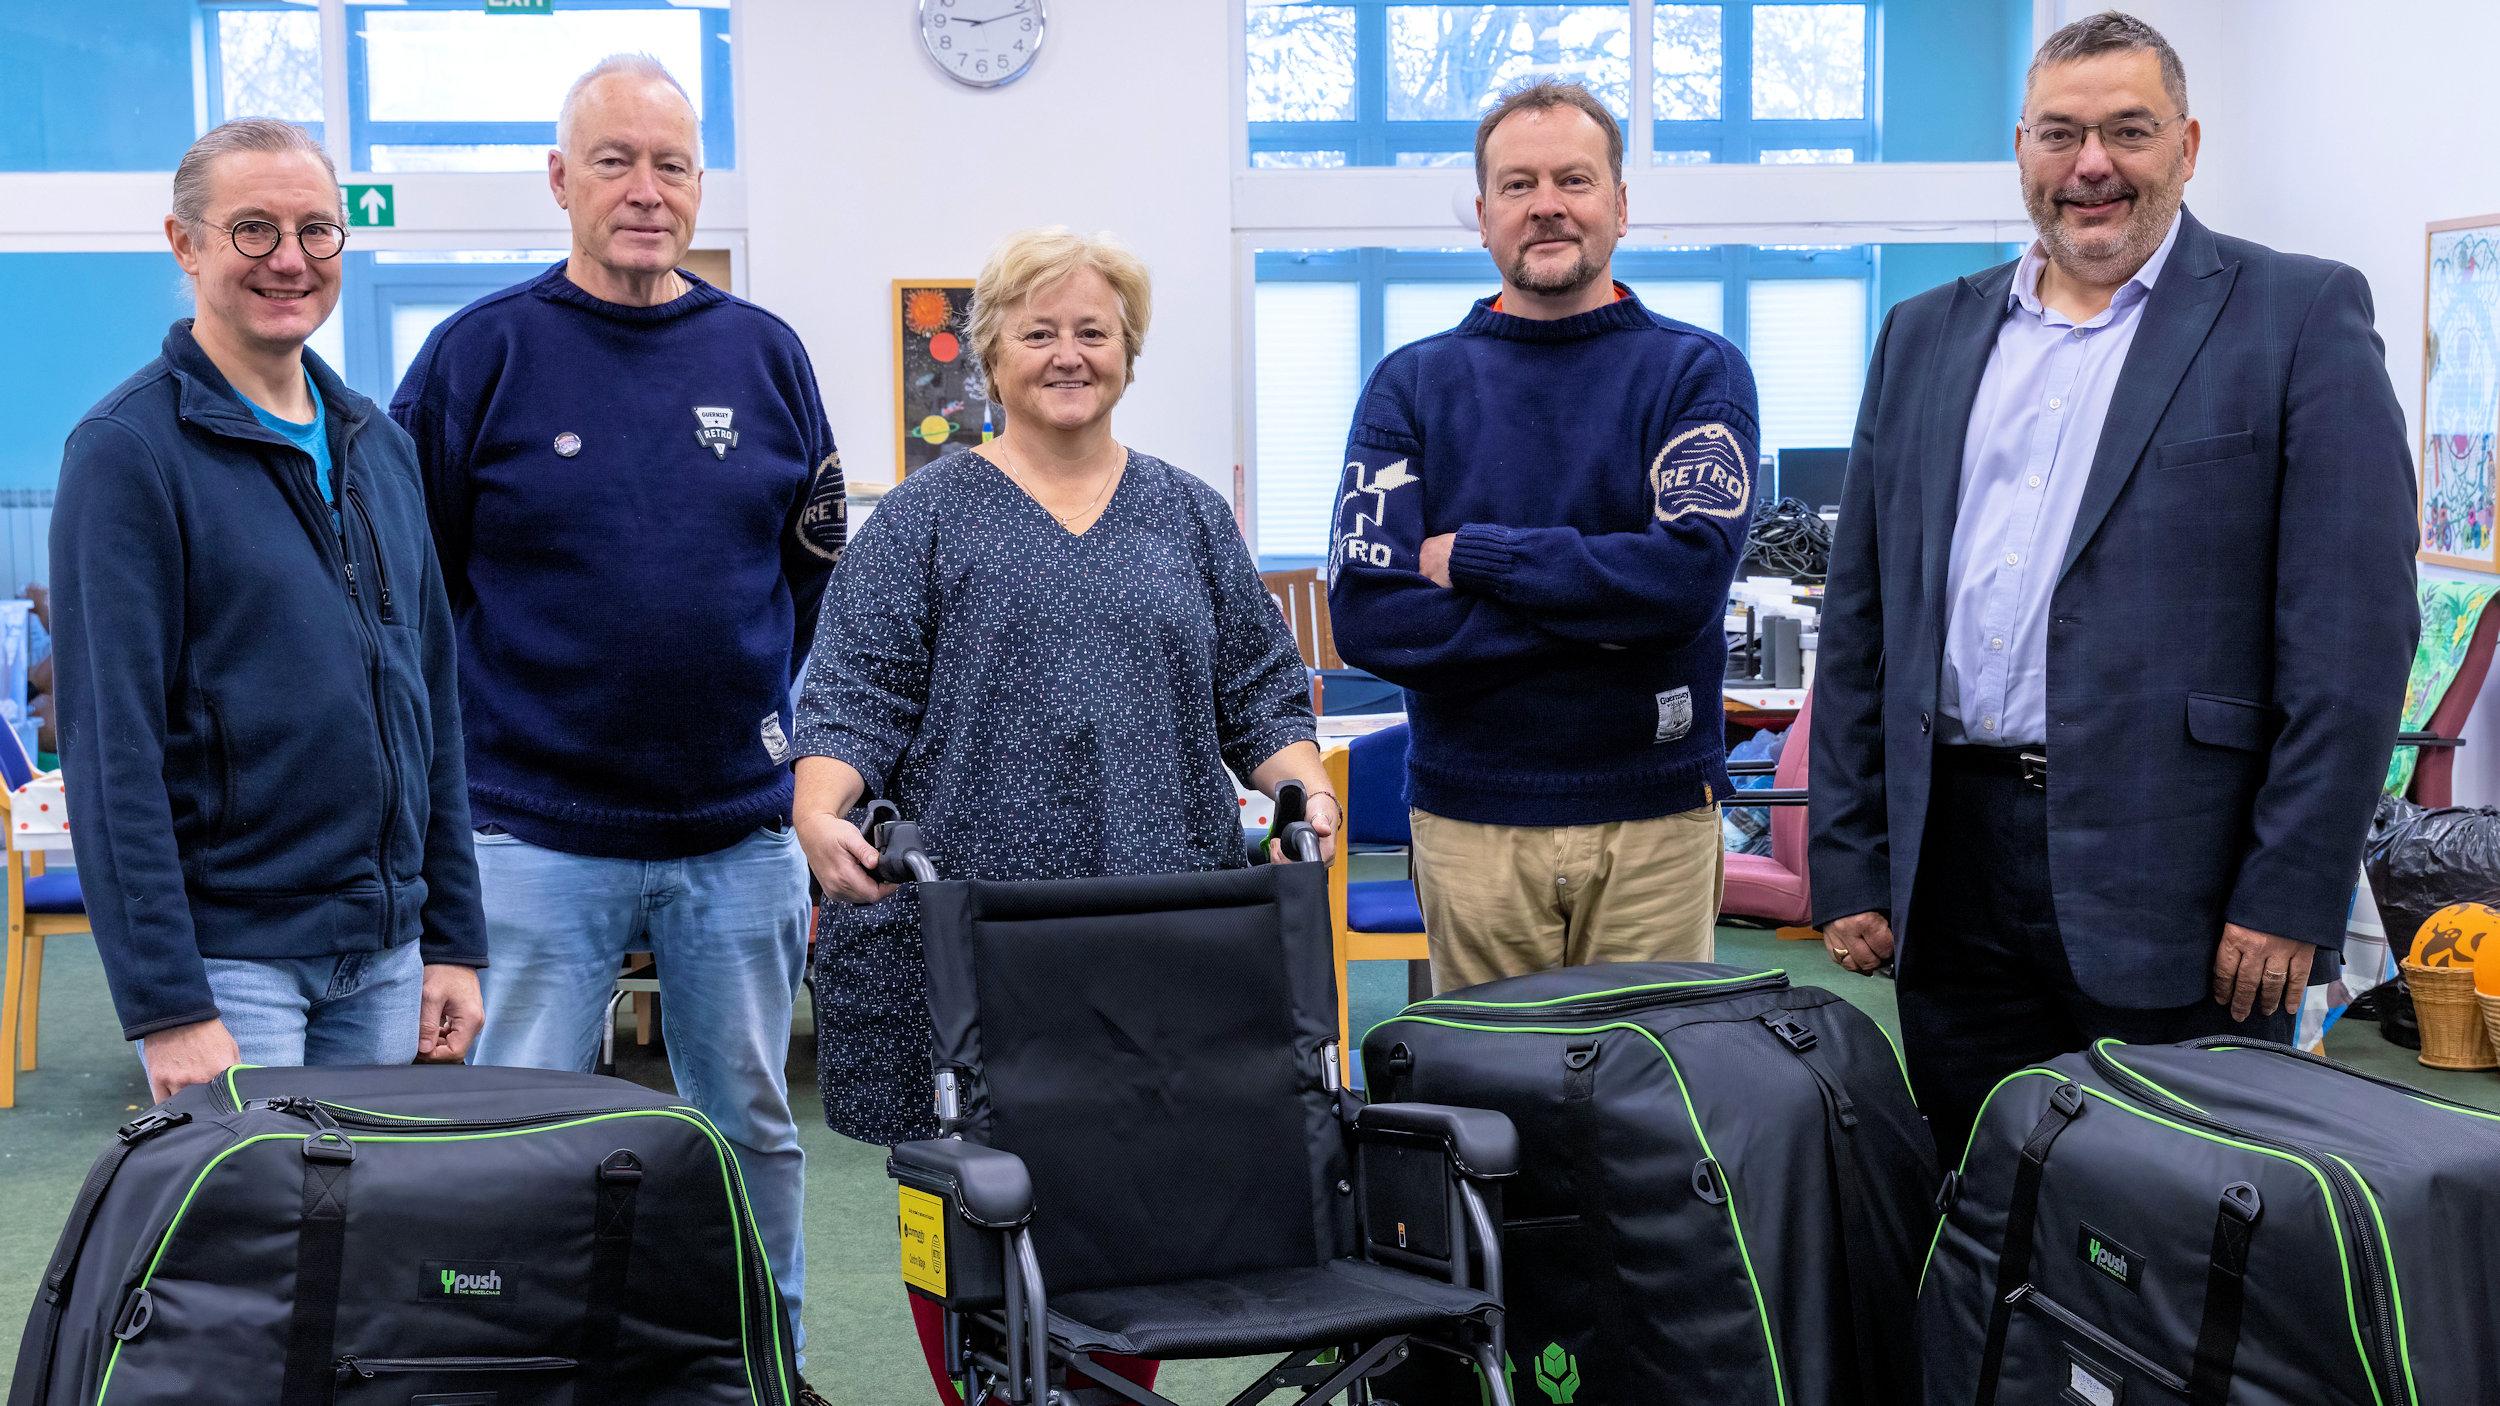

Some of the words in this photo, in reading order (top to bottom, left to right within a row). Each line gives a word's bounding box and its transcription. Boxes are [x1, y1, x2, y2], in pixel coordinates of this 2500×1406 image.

[934, 14, 946, 28] 9
[1020, 17, 1032, 32] 3
[940, 35, 952, 50] 8
[1013, 39, 1024, 52] 4
[958, 53, 969, 67] 7
[976, 59, 988, 74] 6
[997, 54, 1009, 69] 5
[701, 411, 729, 419] GUERNSEY
[704, 429, 732, 440] RETRO
[1659, 461, 1743, 500] RETRO
[1660, 692, 1689, 705] Guernsey
[2089, 1238, 2128, 1277] Ypush
[441, 1269, 502, 1294] Ypush
